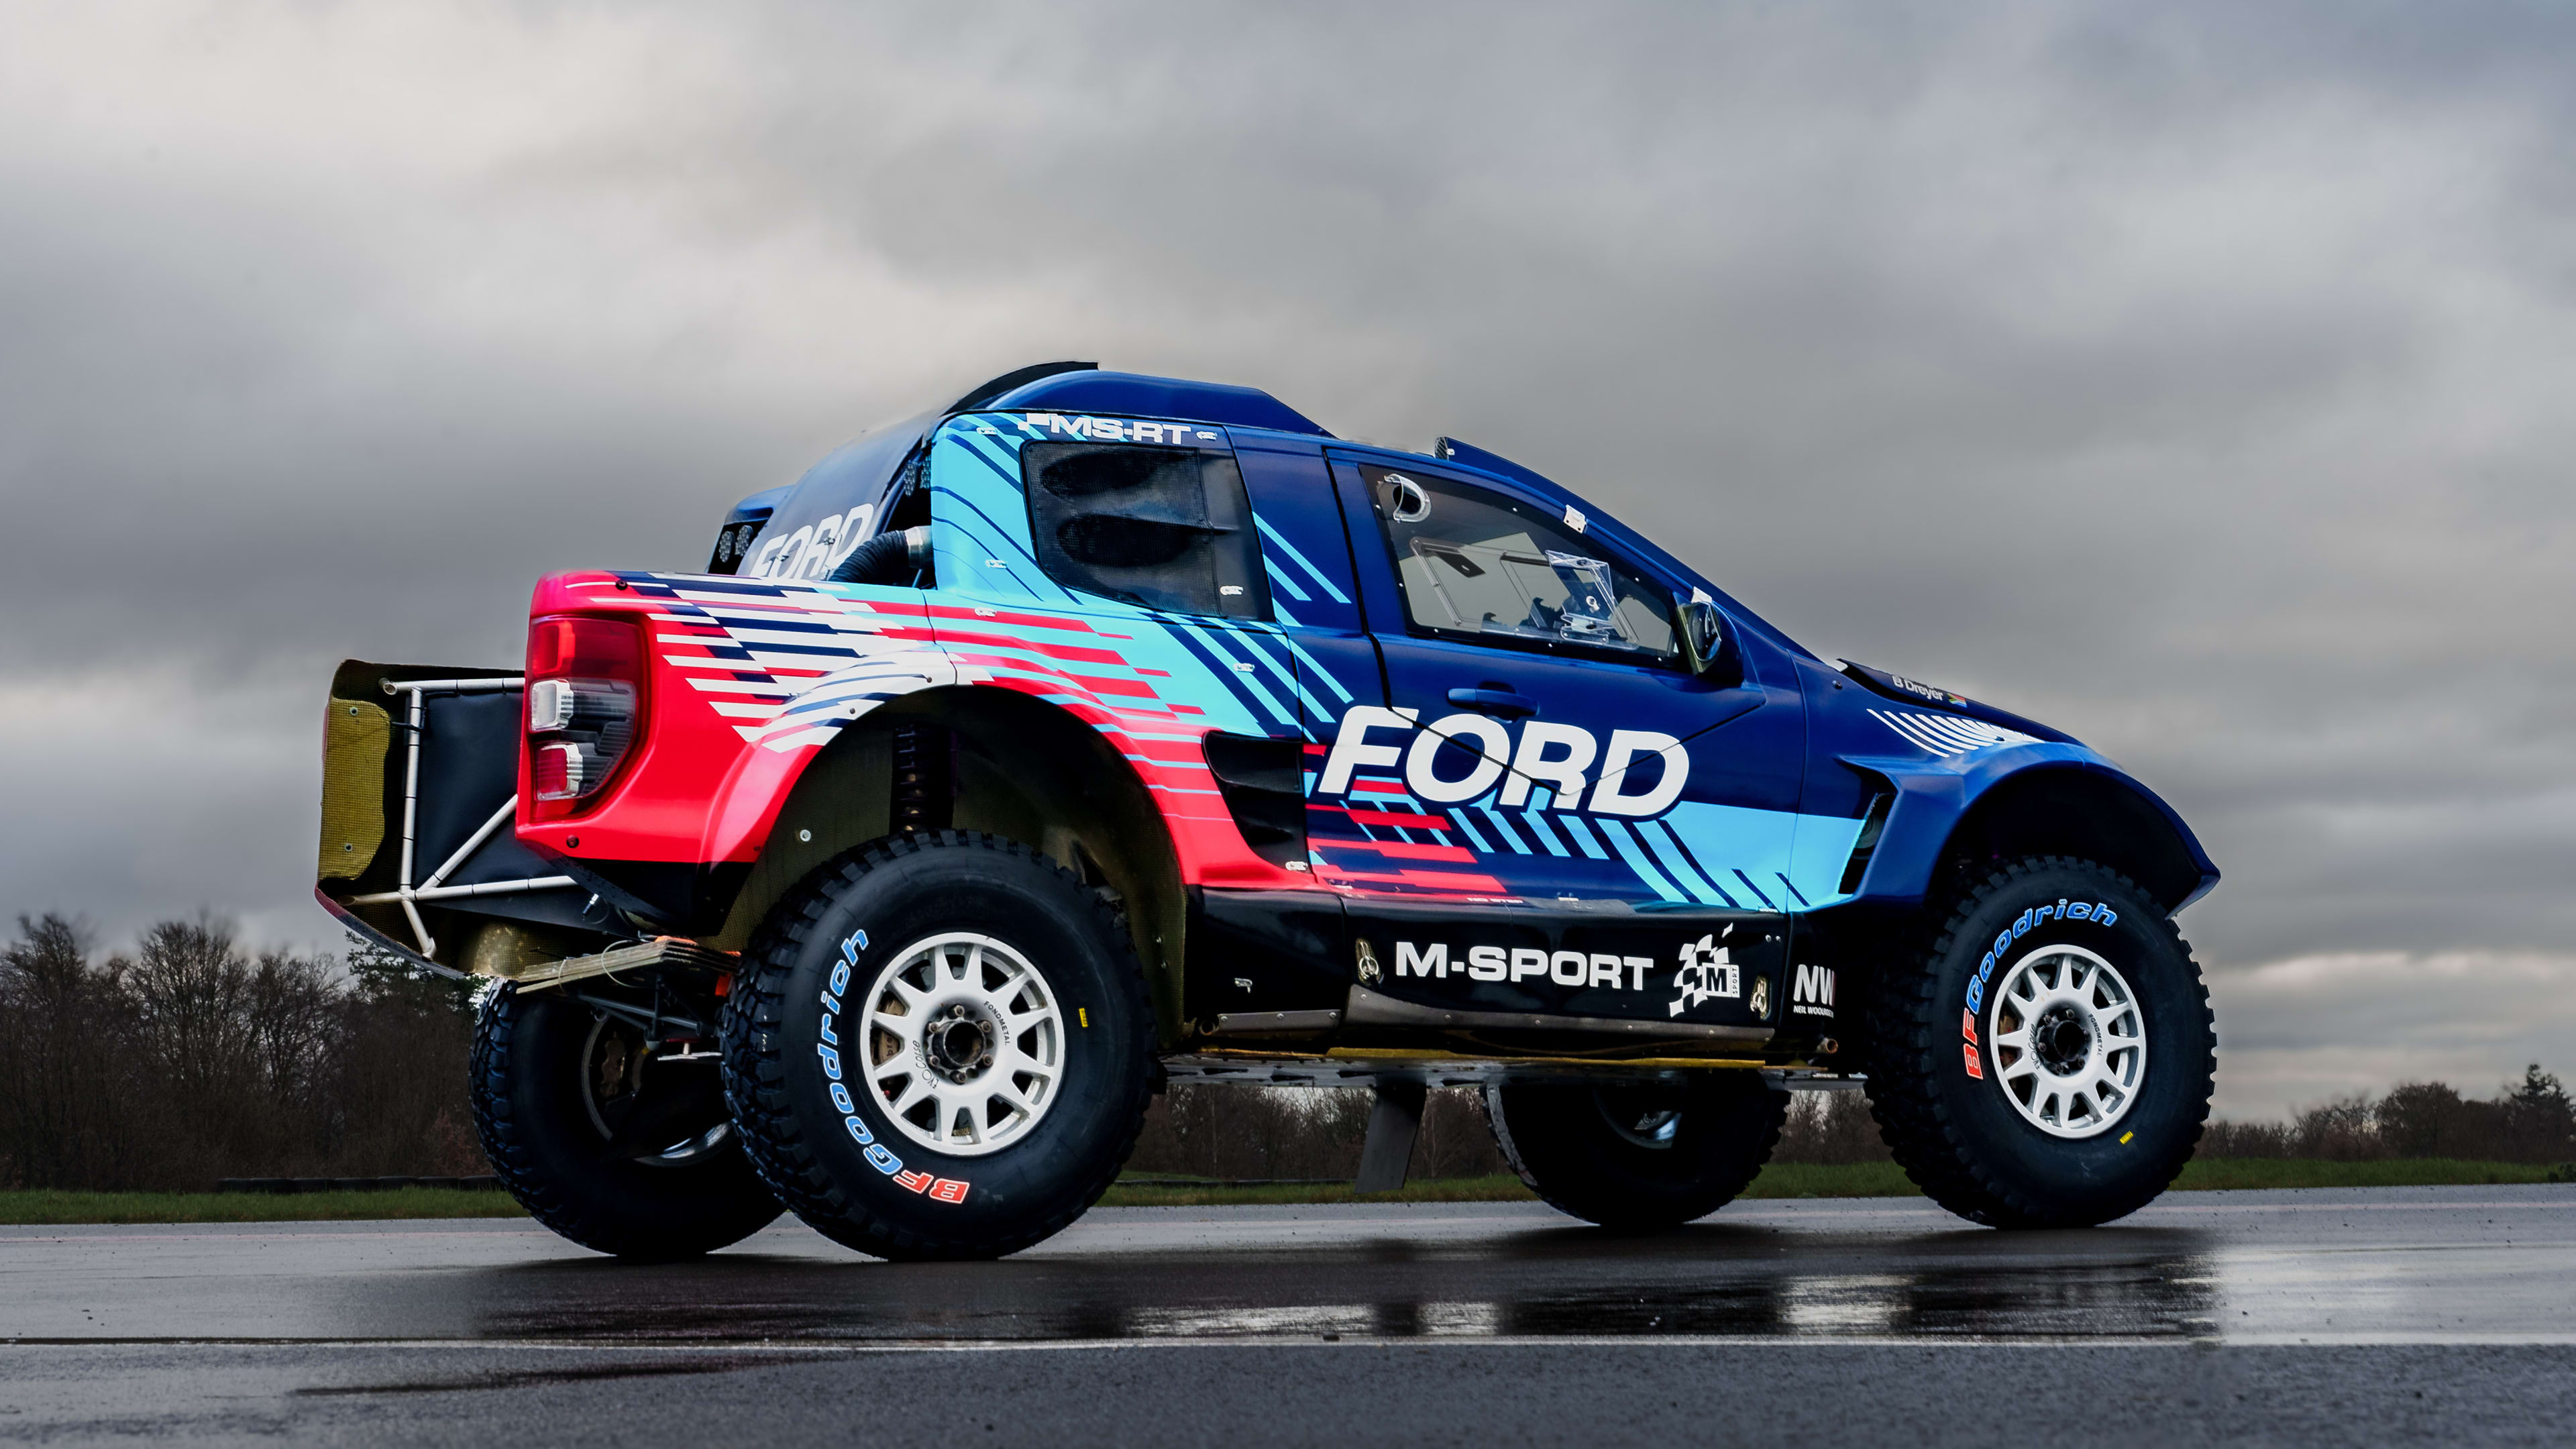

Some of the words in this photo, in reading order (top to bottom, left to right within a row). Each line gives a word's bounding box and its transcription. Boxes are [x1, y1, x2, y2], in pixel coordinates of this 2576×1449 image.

[1046, 413, 1191, 445] MS-RT
[749, 503, 874, 580] FORD
[1892, 675, 1904, 688] B
[1904, 679, 1944, 702] Dreyer
[1318, 705, 1690, 816] FORD
[1396, 941, 1654, 991] M-SPORT
[1706, 967, 1728, 993] M
[1793, 964, 1835, 1007] NW
[1793, 1005, 1807, 1014] NEIL
[1963, 899, 2118, 1080] BFGoodrich
[983, 1000, 1010, 1046] FONDMETAL
[2088, 1014, 2103, 1056] FONDMETAL
[818, 928, 970, 1204] BFGoodrich
